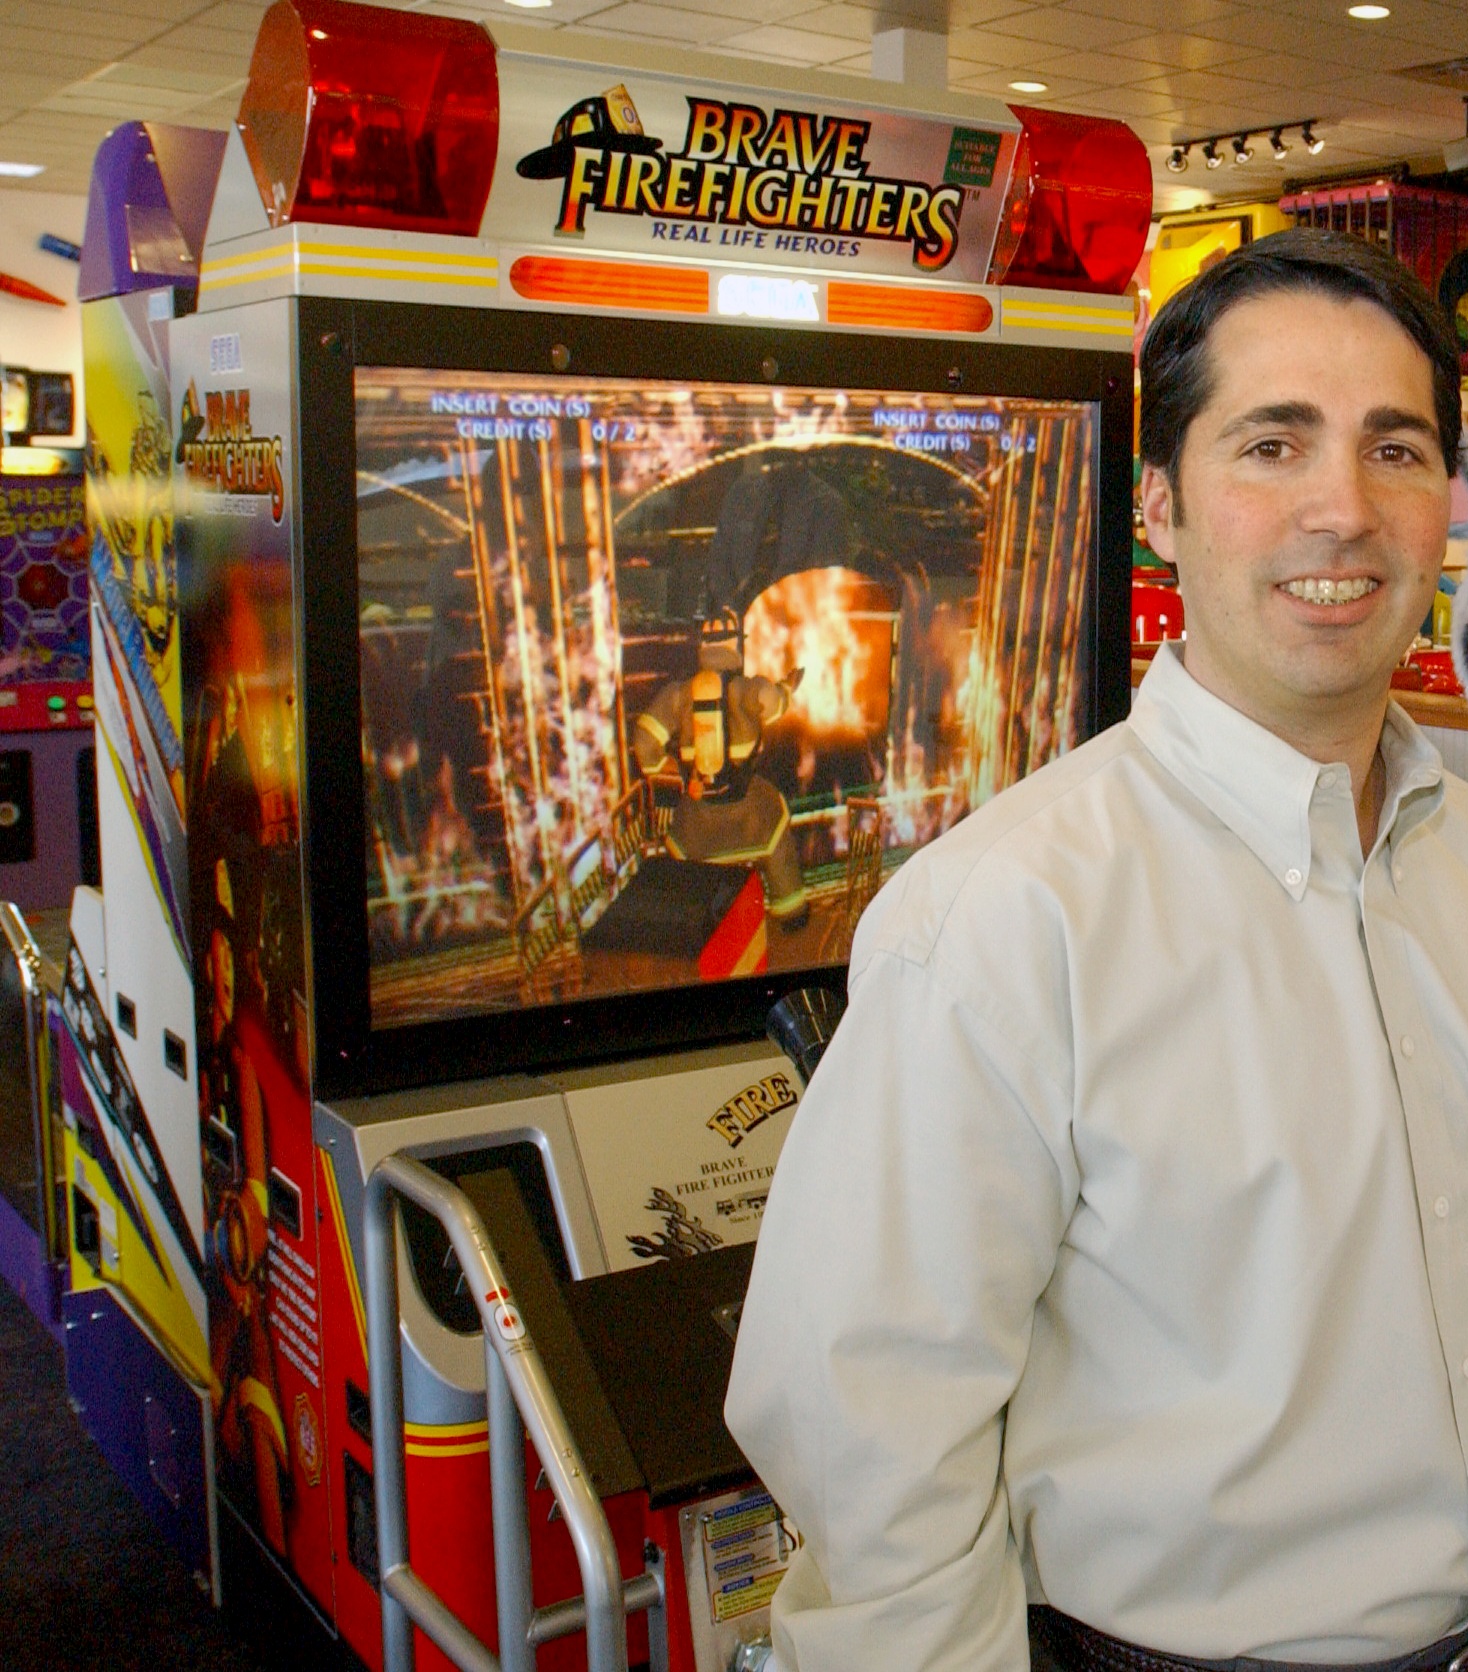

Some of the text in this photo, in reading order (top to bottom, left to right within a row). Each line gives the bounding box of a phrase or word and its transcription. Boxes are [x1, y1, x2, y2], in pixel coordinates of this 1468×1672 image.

[685, 97, 869, 178] BRAVE
[555, 145, 963, 270] FIREFIGHTERS
[652, 221, 862, 257] REAL LIFE HEROES
[431, 394, 591, 418] INSERT COIN (S)
[873, 410, 927, 428] INSERT
[935, 413, 977, 430] COIN
[457, 418, 525, 440] CREDIT
[528, 421, 552, 442] (S)
[895, 431, 948, 450] CREDIT
[951, 433, 970, 451] (S)
[706, 1071, 799, 1148] FIRE
[700, 1156, 748, 1175] BRAVE
[676, 1164, 777, 1196] FIRE FIGHTER
